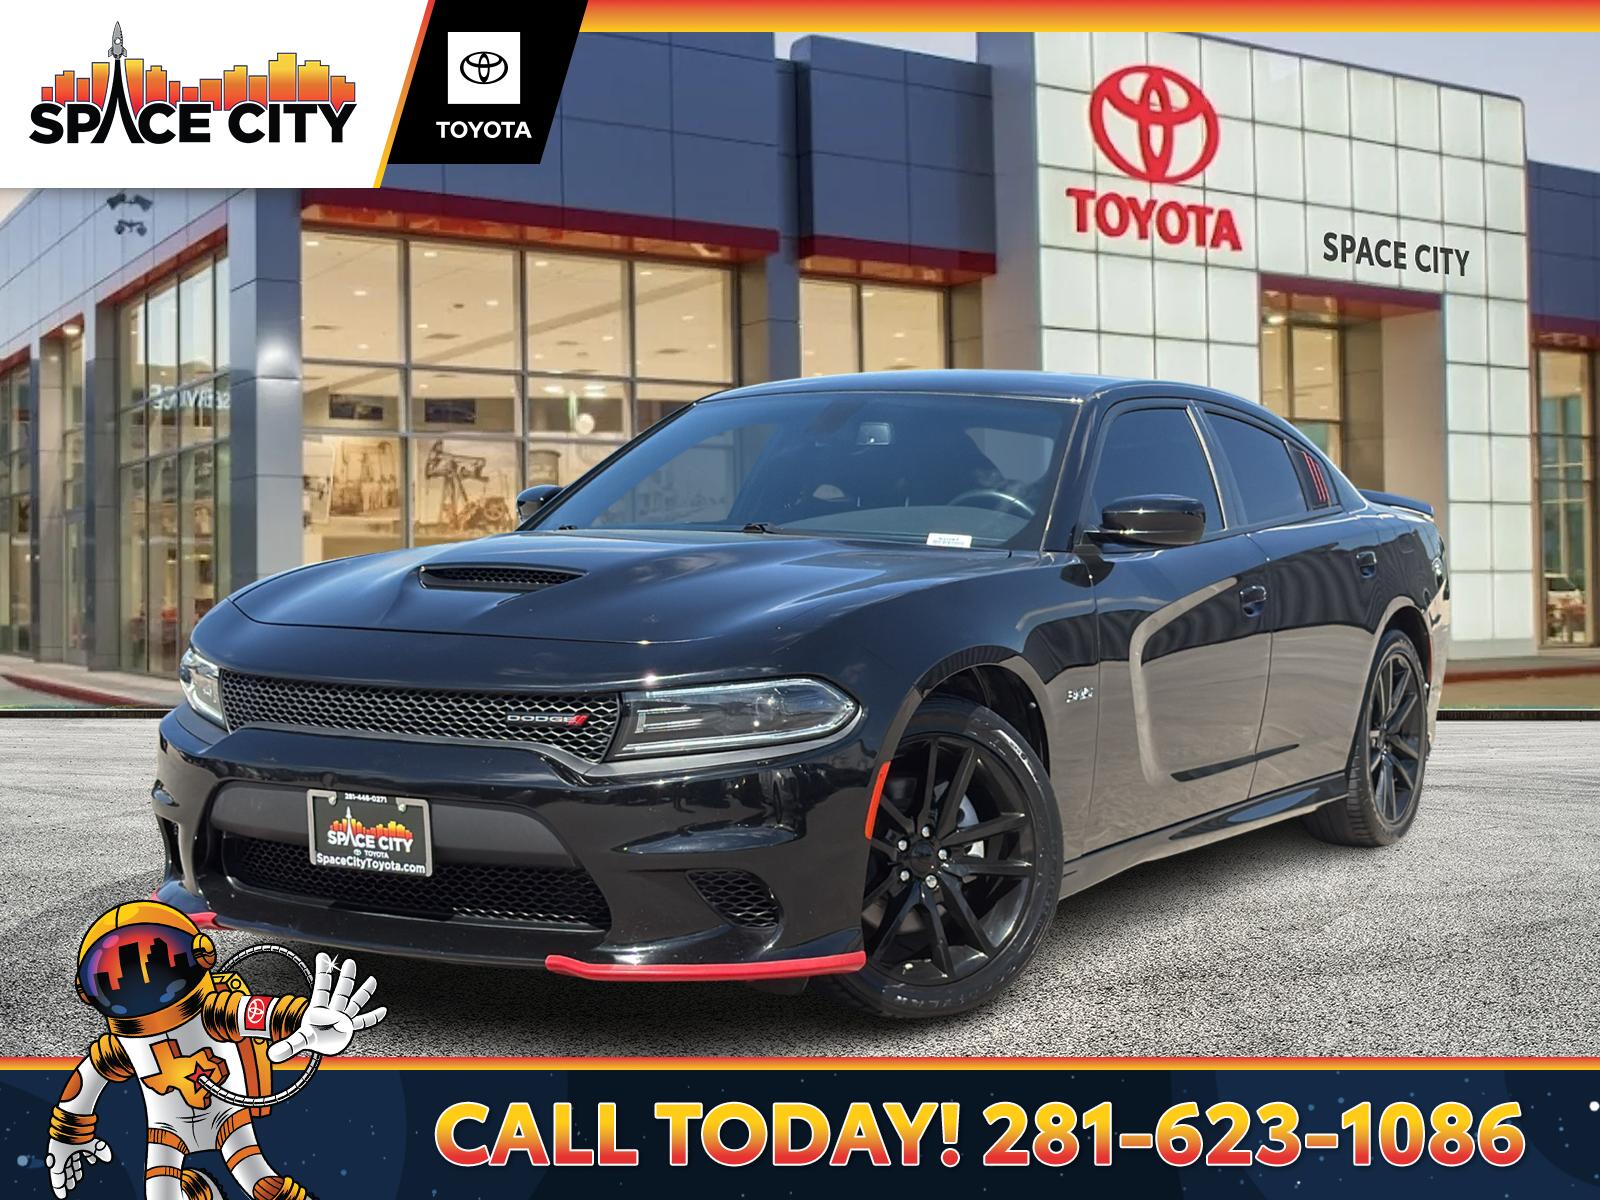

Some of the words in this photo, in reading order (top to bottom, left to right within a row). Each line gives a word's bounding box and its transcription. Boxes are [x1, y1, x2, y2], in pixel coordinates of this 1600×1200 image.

[1066, 188, 1243, 252] TOYOTA
[1323, 232, 1407, 270] SPACE
[1415, 245, 1470, 277] CITY
[507, 714, 576, 723] DODGE
[378, 836, 413, 853] CITY
[316, 852, 426, 874] SpaceCityToyota.com
[364, 850, 389, 859] TOYOTA
